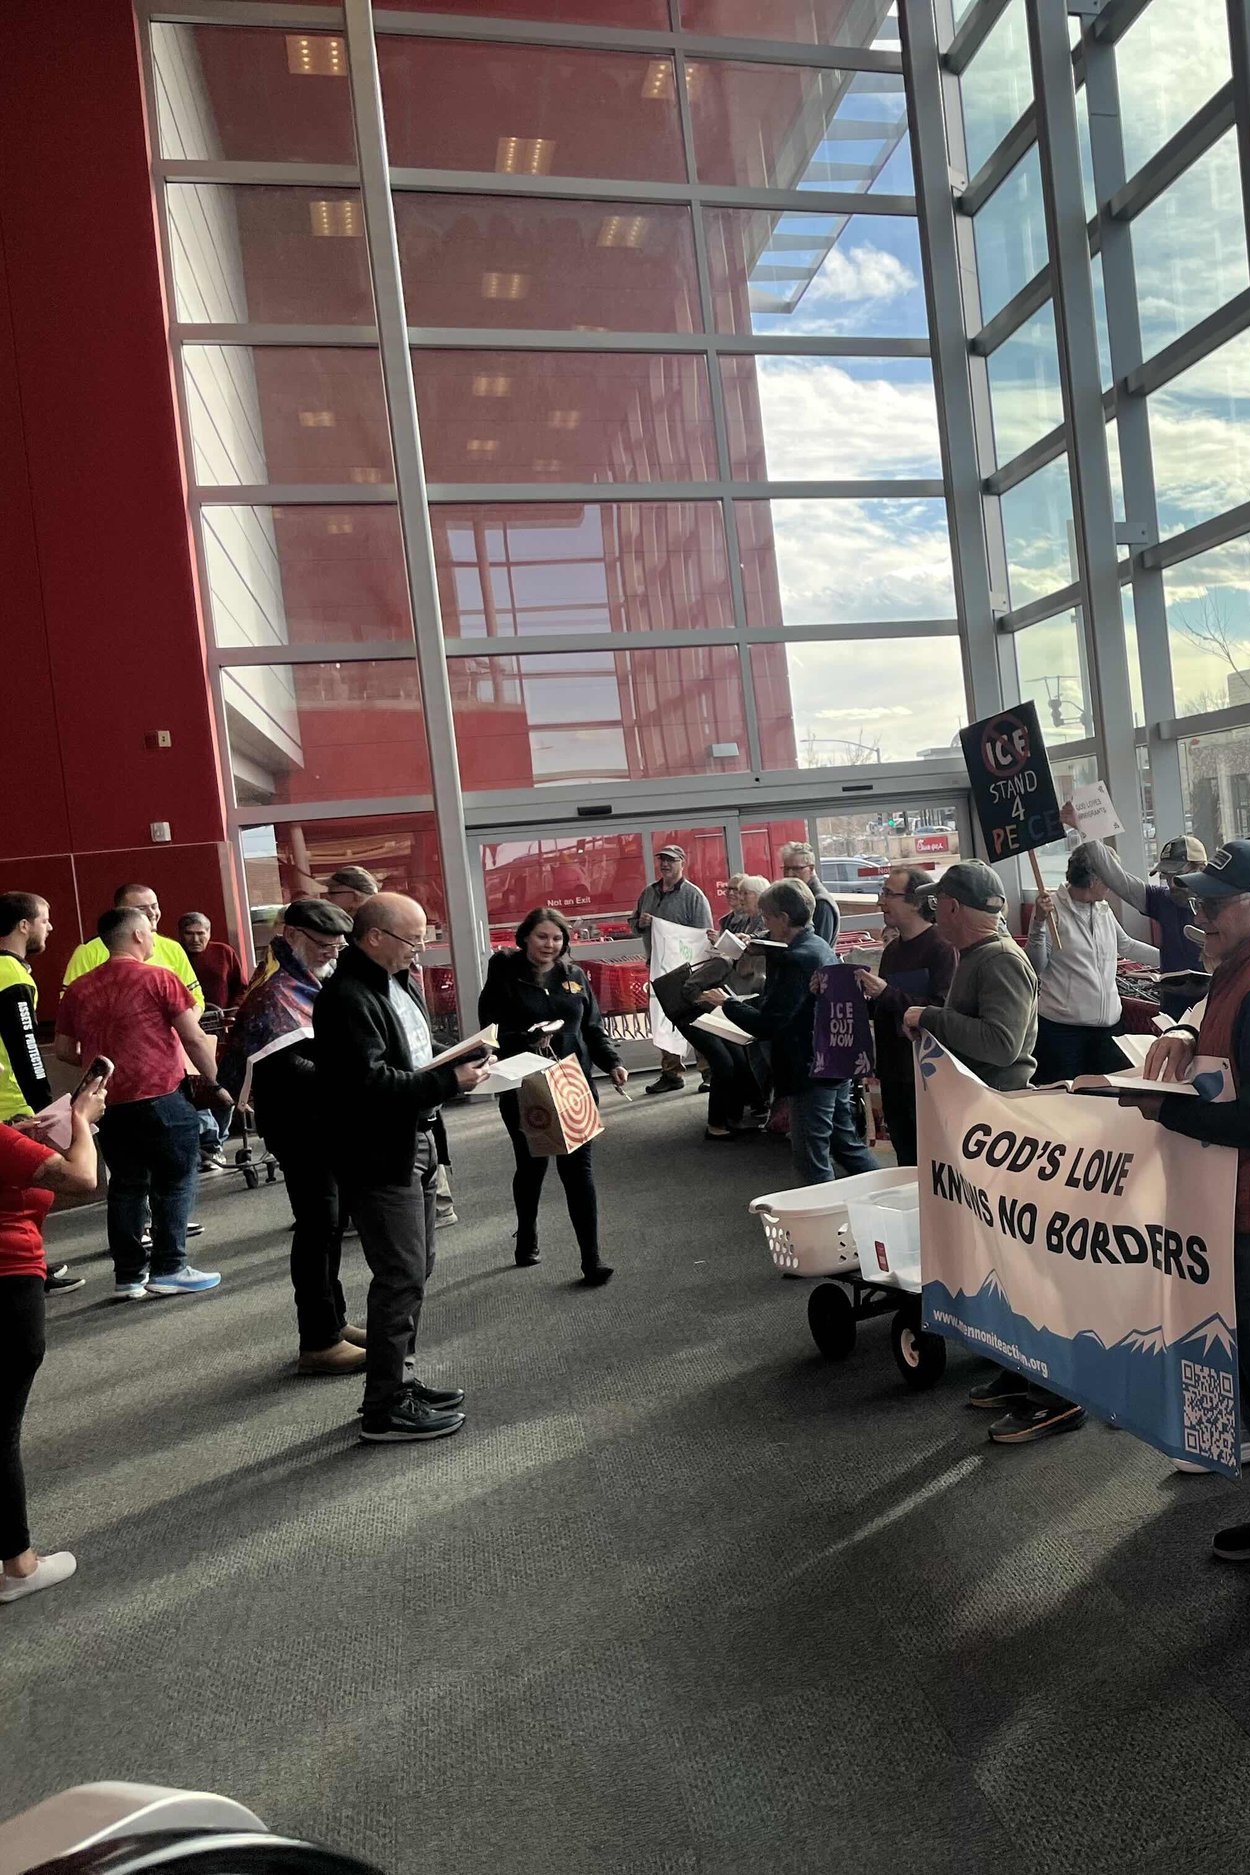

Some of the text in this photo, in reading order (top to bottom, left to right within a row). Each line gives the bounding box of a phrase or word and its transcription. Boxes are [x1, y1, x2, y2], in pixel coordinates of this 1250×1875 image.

[985, 726, 1031, 768] ICE
[989, 770, 1037, 804] STAND
[1011, 795, 1025, 821] 4
[547, 899, 562, 907] Not
[576, 896, 591, 904] Exit
[830, 1001, 853, 1018] ICE
[17, 1001, 46, 1080] ASSETS PROTECTION
[830, 1020, 853, 1034] OUT
[830, 1034, 854, 1047] NOW
[962, 1123, 1134, 1196] GOD'S LOVE
[998, 1195, 1038, 1245] NO
[1046, 1211, 1210, 1285] BORDERS
